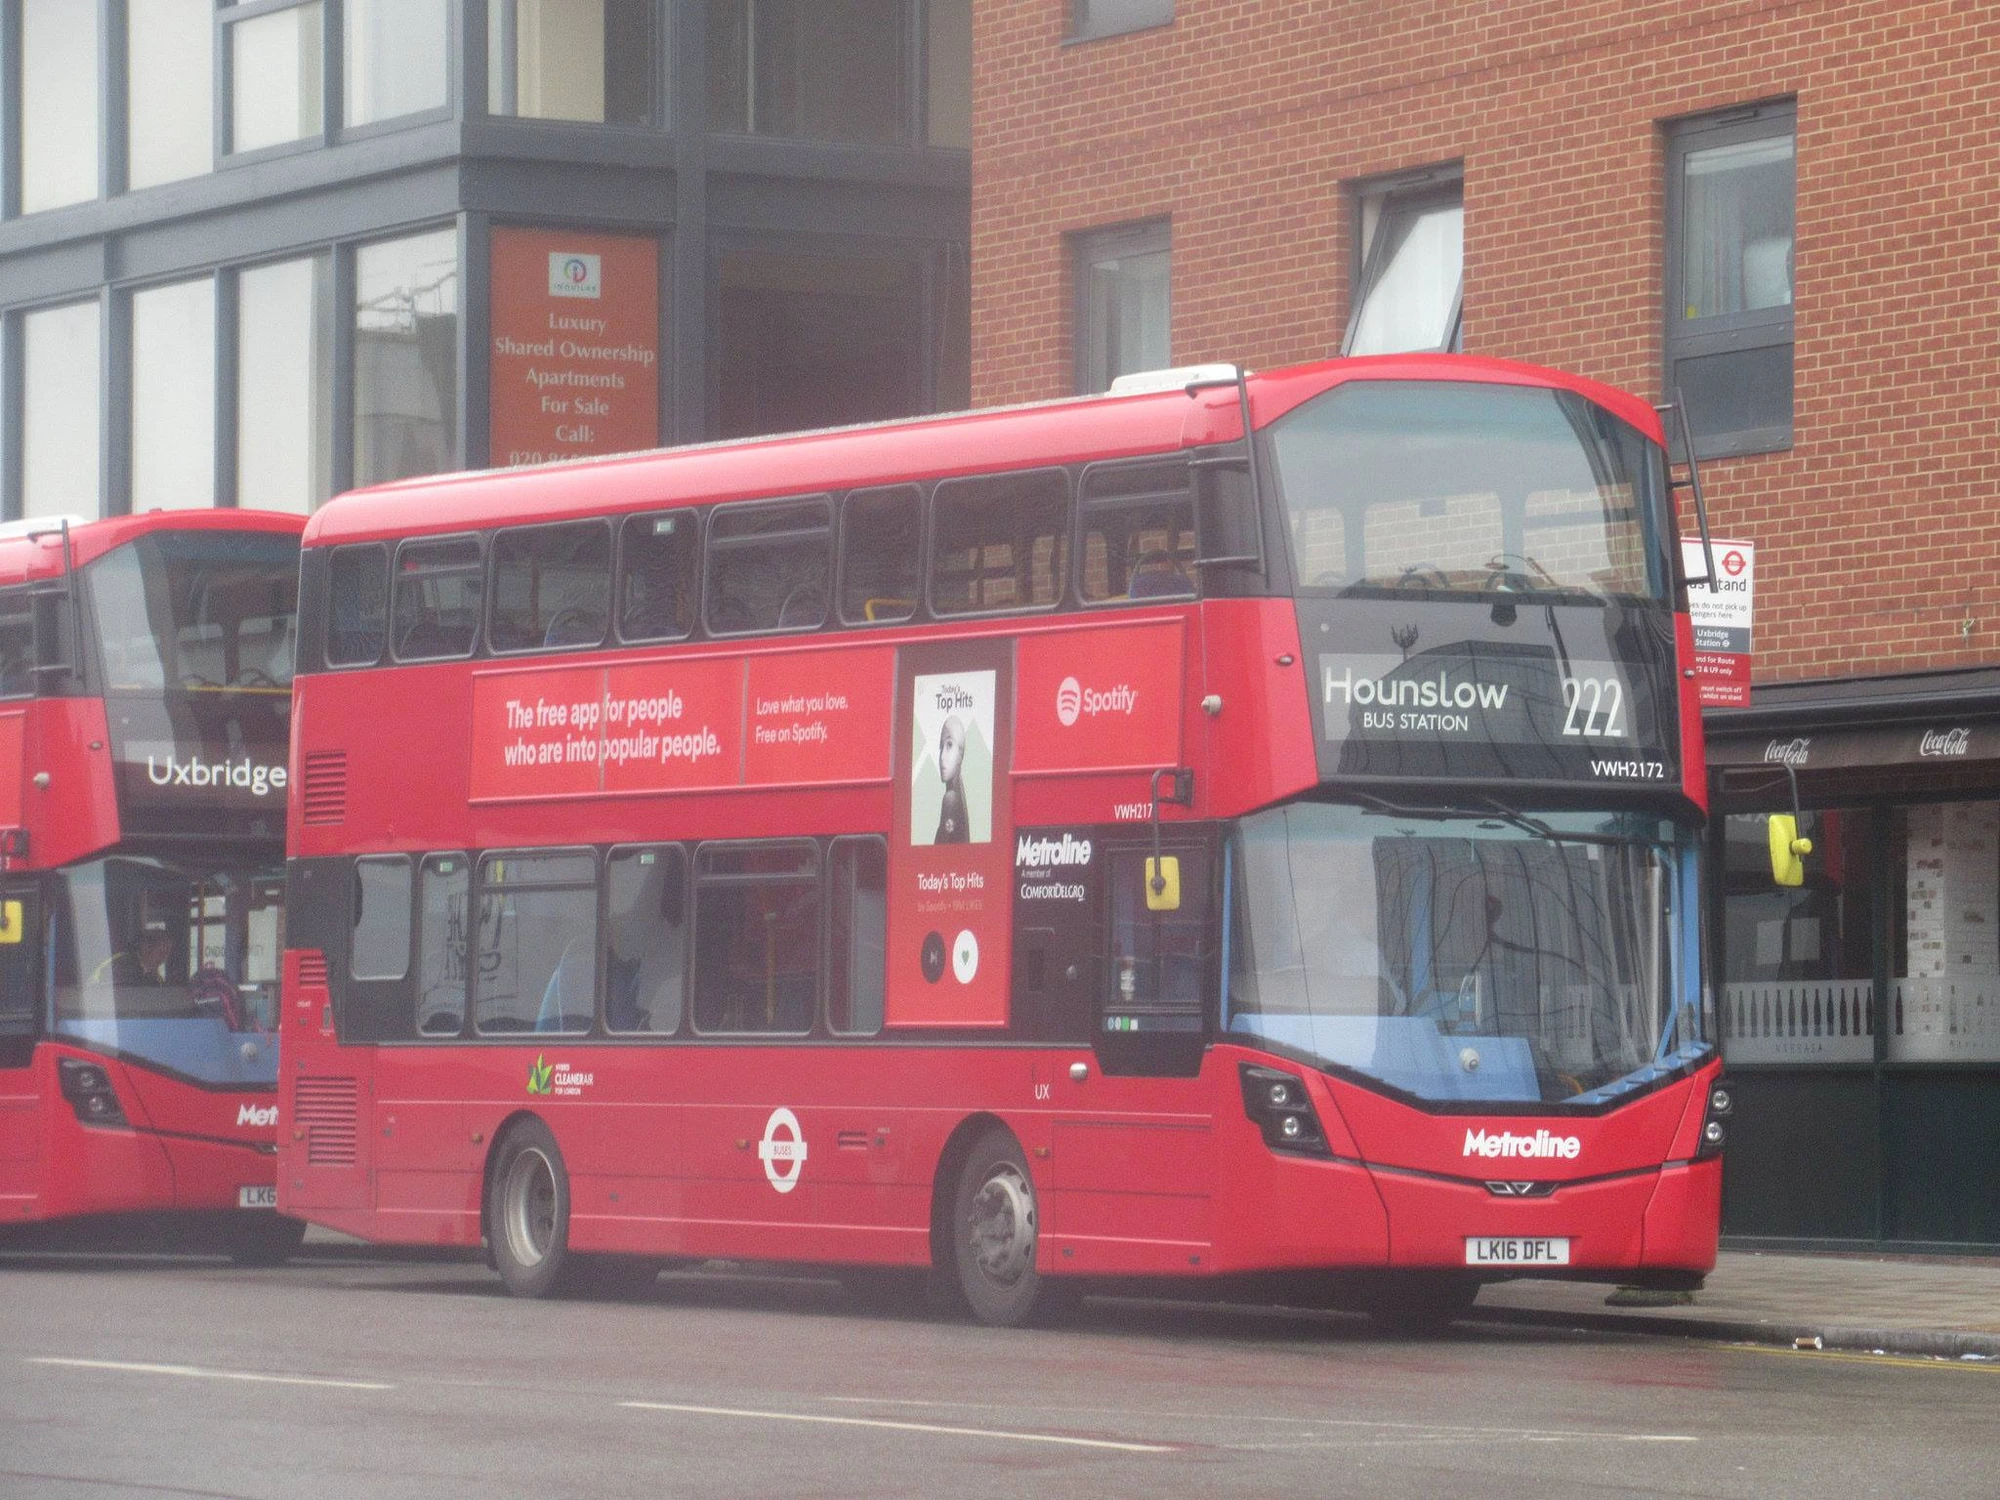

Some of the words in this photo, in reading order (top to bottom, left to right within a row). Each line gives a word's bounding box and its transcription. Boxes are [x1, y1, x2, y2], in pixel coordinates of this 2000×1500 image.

[549, 313, 606, 336] Luxury
[495, 337, 554, 357] Shared
[560, 341, 655, 367] Ownership
[526, 368, 625, 389] Apartments
[541, 396, 568, 413] For
[575, 398, 609, 415] Sale
[555, 425, 595, 442] Call:
[1717, 578, 1747, 592] tand
[1691, 611, 1717, 619] sengers
[1695, 638, 1720, 648] Station
[1697, 629, 1729, 640] Uxbridge
[1717, 656, 1735, 665] Route
[506, 699, 534, 729] The
[537, 698, 567, 727] free
[570, 701, 600, 731] app
[604, 692, 626, 723] for
[627, 688, 684, 728] people
[756, 697, 780, 716] Love
[780, 694, 805, 714] what
[806, 697, 824, 716] you
[825, 692, 848, 711] love.
[936, 693, 953, 713] Top
[954, 691, 974, 709] Hits
[1083, 684, 1137, 716] Spotify
[1325, 667, 1508, 709] Hounslow
[1562, 678, 1622, 736] 222
[756, 725, 776, 744] Free
[778, 727, 790, 742] on
[792, 720, 828, 745] Spotify.
[1363, 712, 1395, 729] BUS
[1400, 713, 1469, 732] STATION
[505, 737, 536, 766] who
[538, 741, 563, 765] are
[566, 733, 596, 762] into
[598, 729, 658, 766] popular
[661, 725, 721, 764] people.
[148, 755, 287, 795] Uxbridge
[1591, 760, 1664, 778] VWH2172
[1114, 803, 1153, 820] VWH217
[1016, 833, 1092, 867] Metroline
[917, 873, 948, 893] Today's
[950, 872, 966, 892] Top
[967, 871, 984, 889] Hits
[1035, 1084, 1049, 1100] UX
[236, 1103, 279, 1126] Met
[773, 1145, 792, 1156] BUSES
[1463, 1127, 1581, 1159] Metroline
[246, 1186, 276, 1205] LK6
[1477, 1241, 1517, 1260] LK16
[1523, 1241, 1558, 1260] DFL
